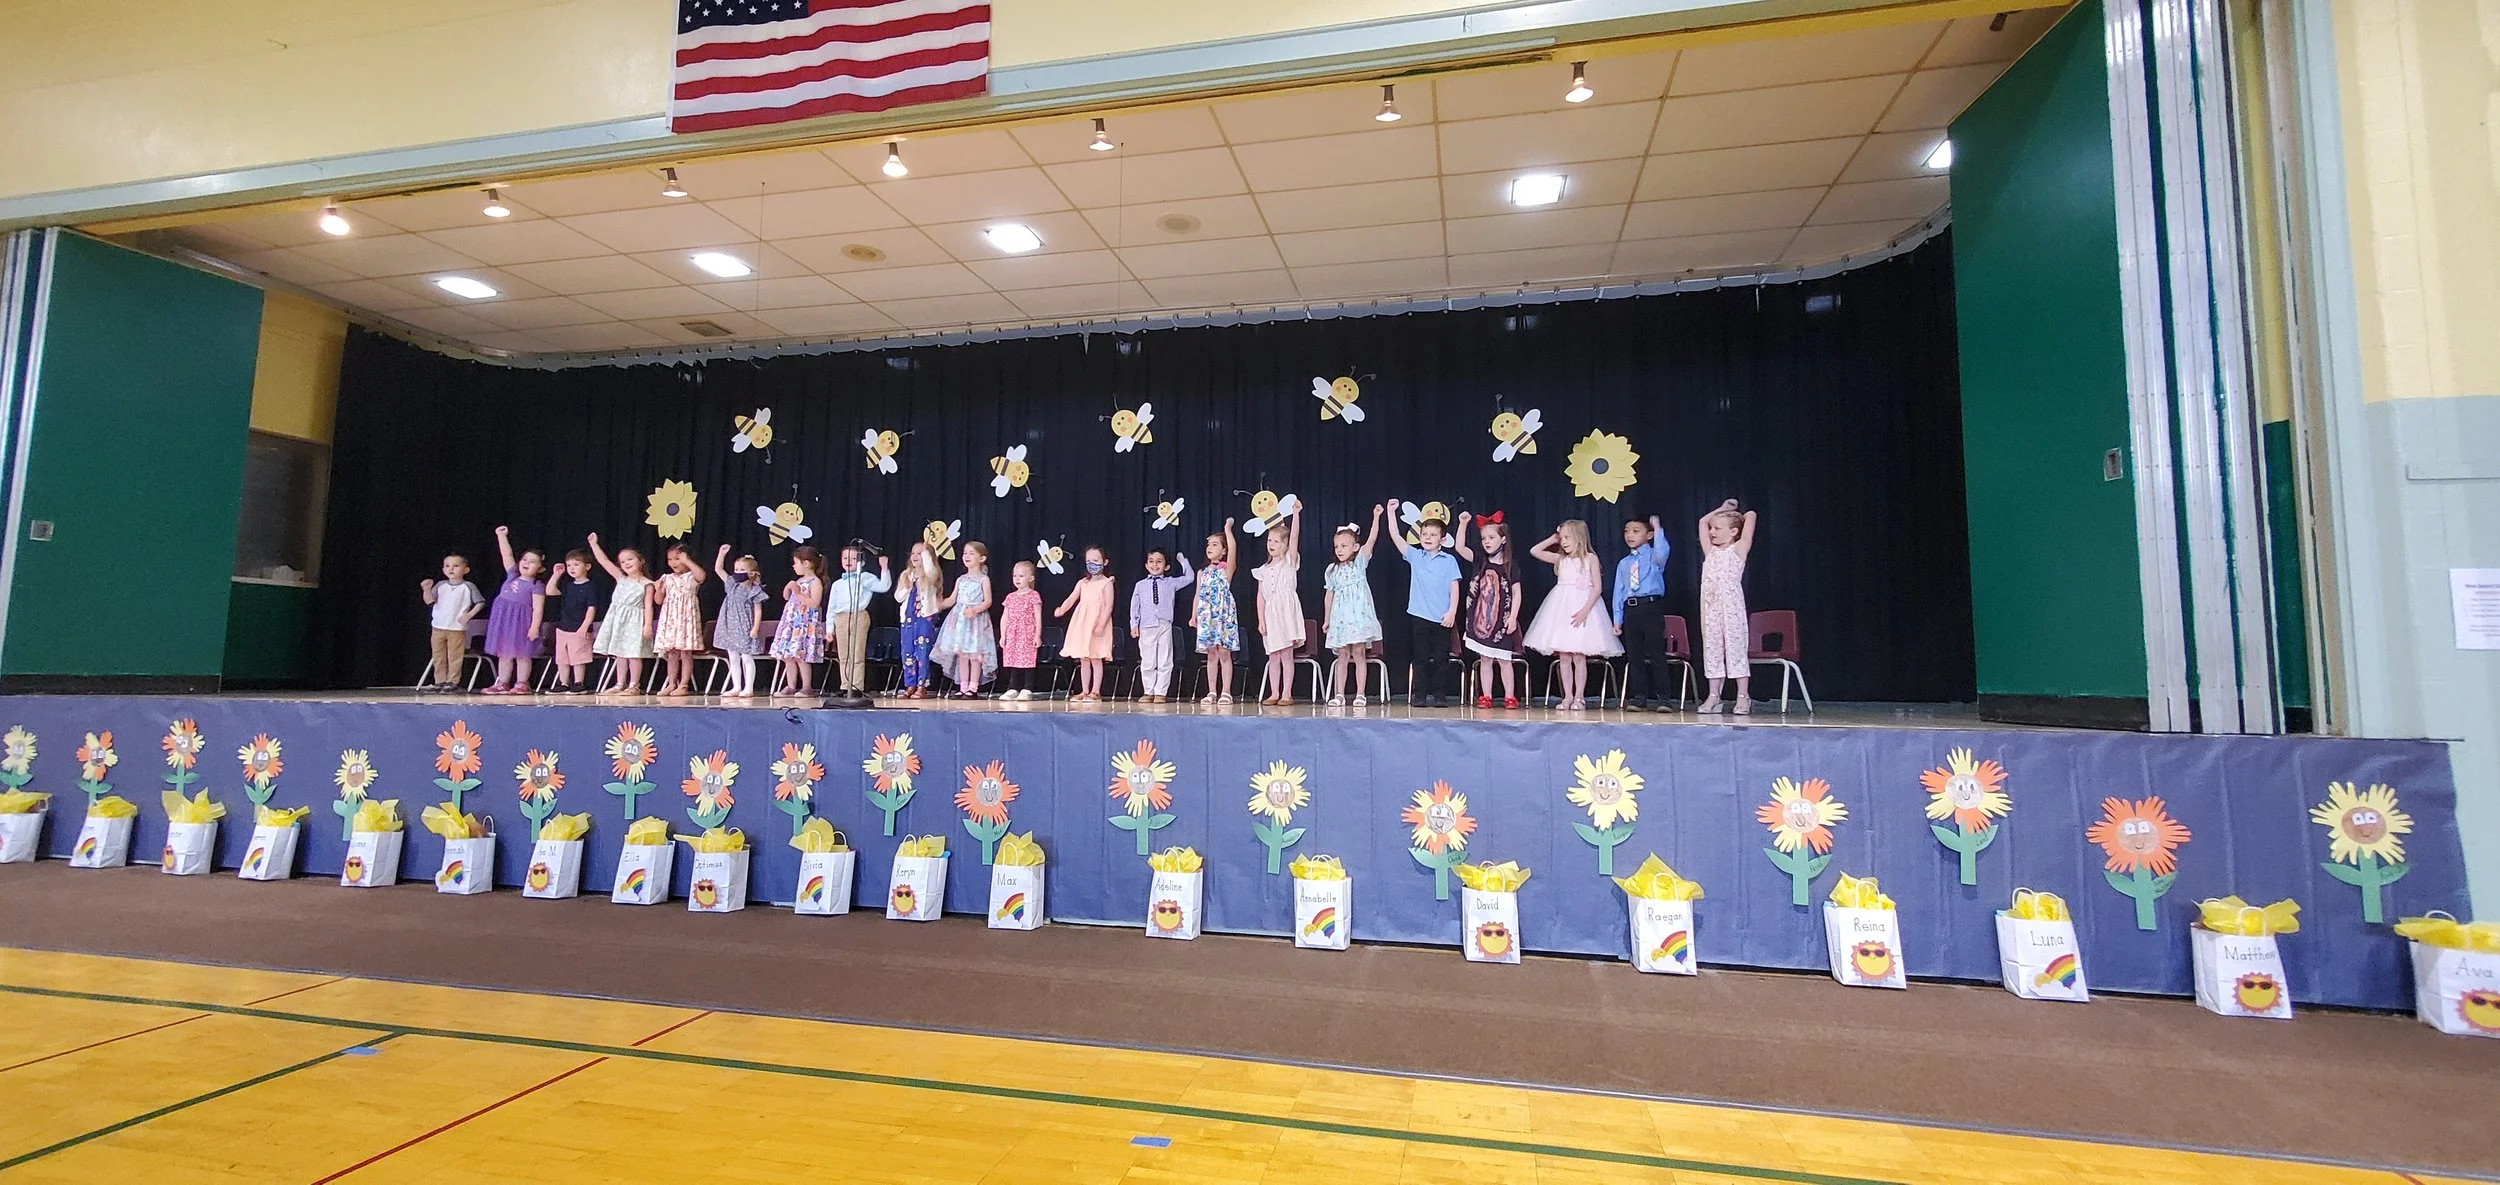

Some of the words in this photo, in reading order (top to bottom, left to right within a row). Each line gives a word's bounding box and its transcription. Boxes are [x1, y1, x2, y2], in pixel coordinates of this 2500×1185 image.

[624, 852, 641, 862] Ella
[695, 858, 722, 871] Optimus
[803, 860, 823, 871] Olivia
[997, 872, 1017, 886] Max
[1154, 877, 1183, 892] Adeline
[1300, 887, 1337, 902] Annabelle
[1476, 897, 1499, 911] David
[1647, 907, 1683, 924] Raegan
[1854, 917, 1886, 932] Reina
[2030, 930, 2065, 946] Luna
[2455, 957, 2494, 978] Ava
